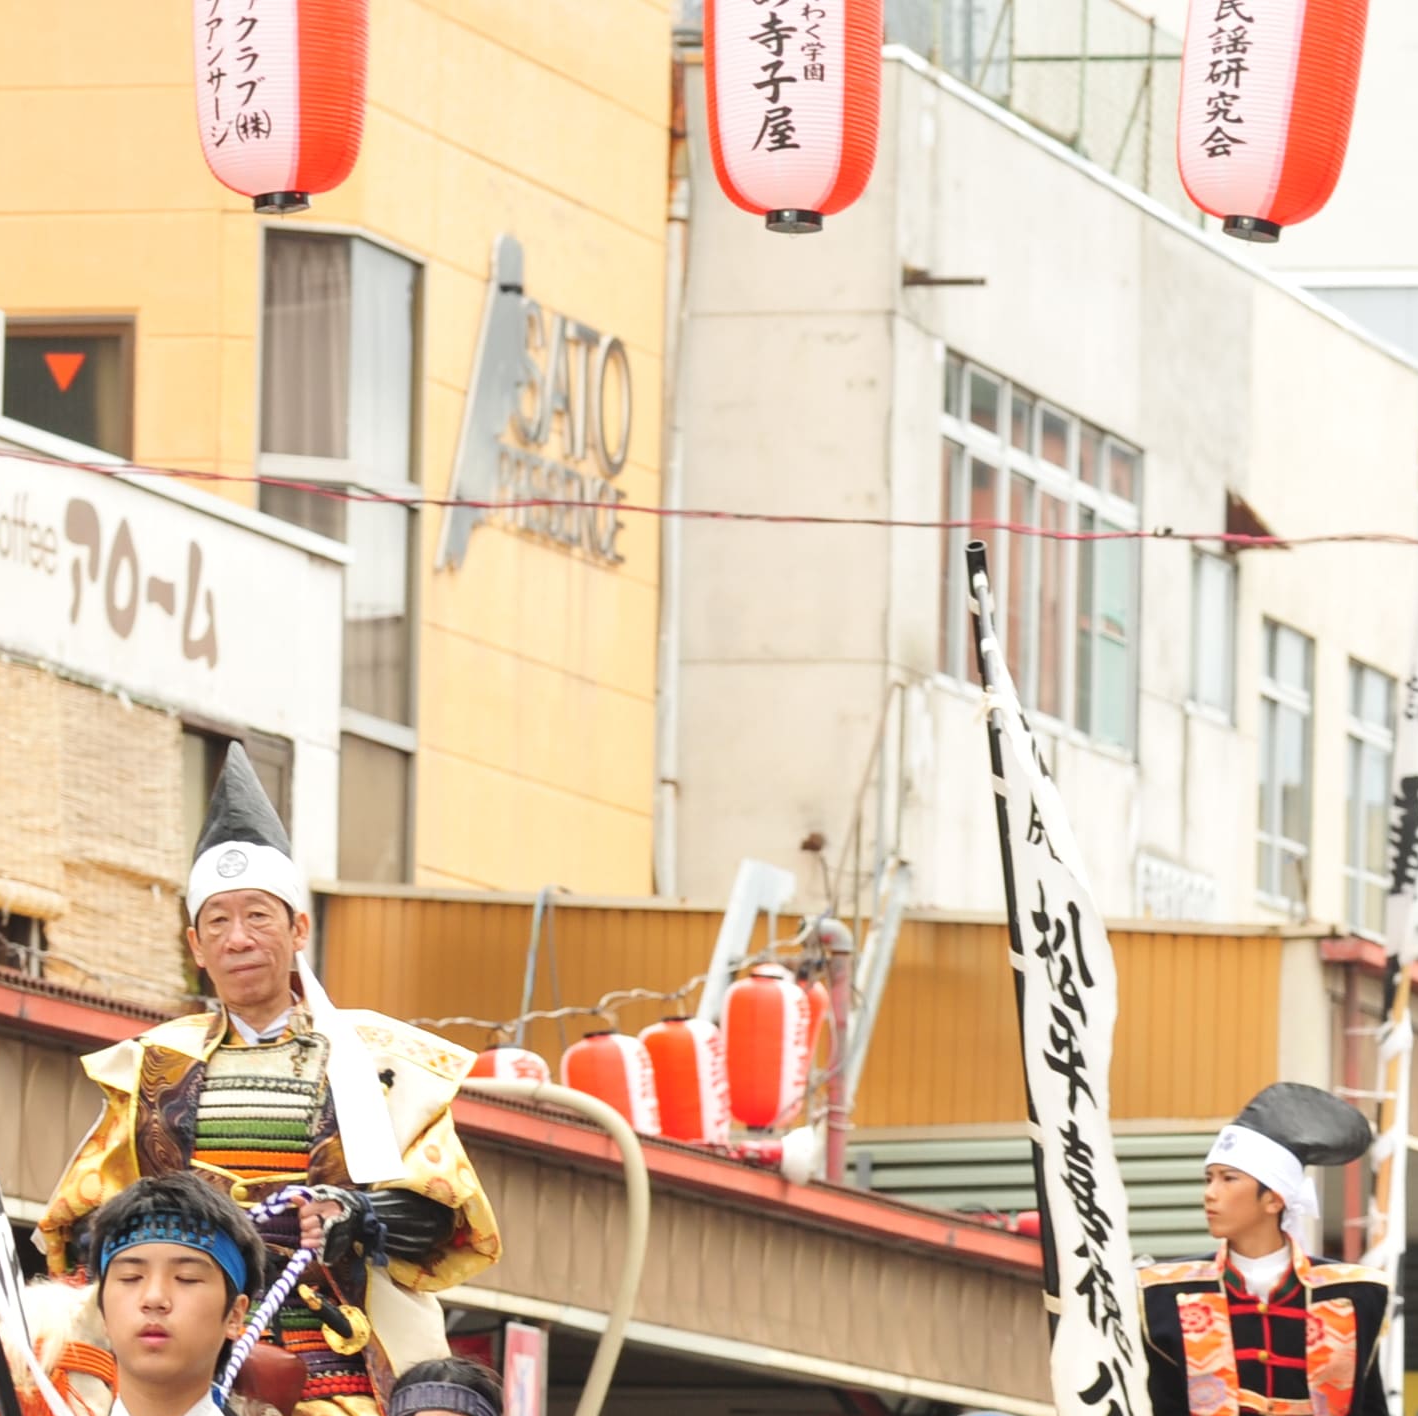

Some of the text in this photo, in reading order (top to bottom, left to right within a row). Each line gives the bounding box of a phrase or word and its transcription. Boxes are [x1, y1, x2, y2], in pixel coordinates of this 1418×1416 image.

[236, 0, 272, 143] クラブ(株)
[749, 0, 801, 153] 寺子屋
[801, 0, 826, 81] わく学園
[1200, 0, 1254, 158] 民謡研究会
[512, 294, 632, 479] SATO
